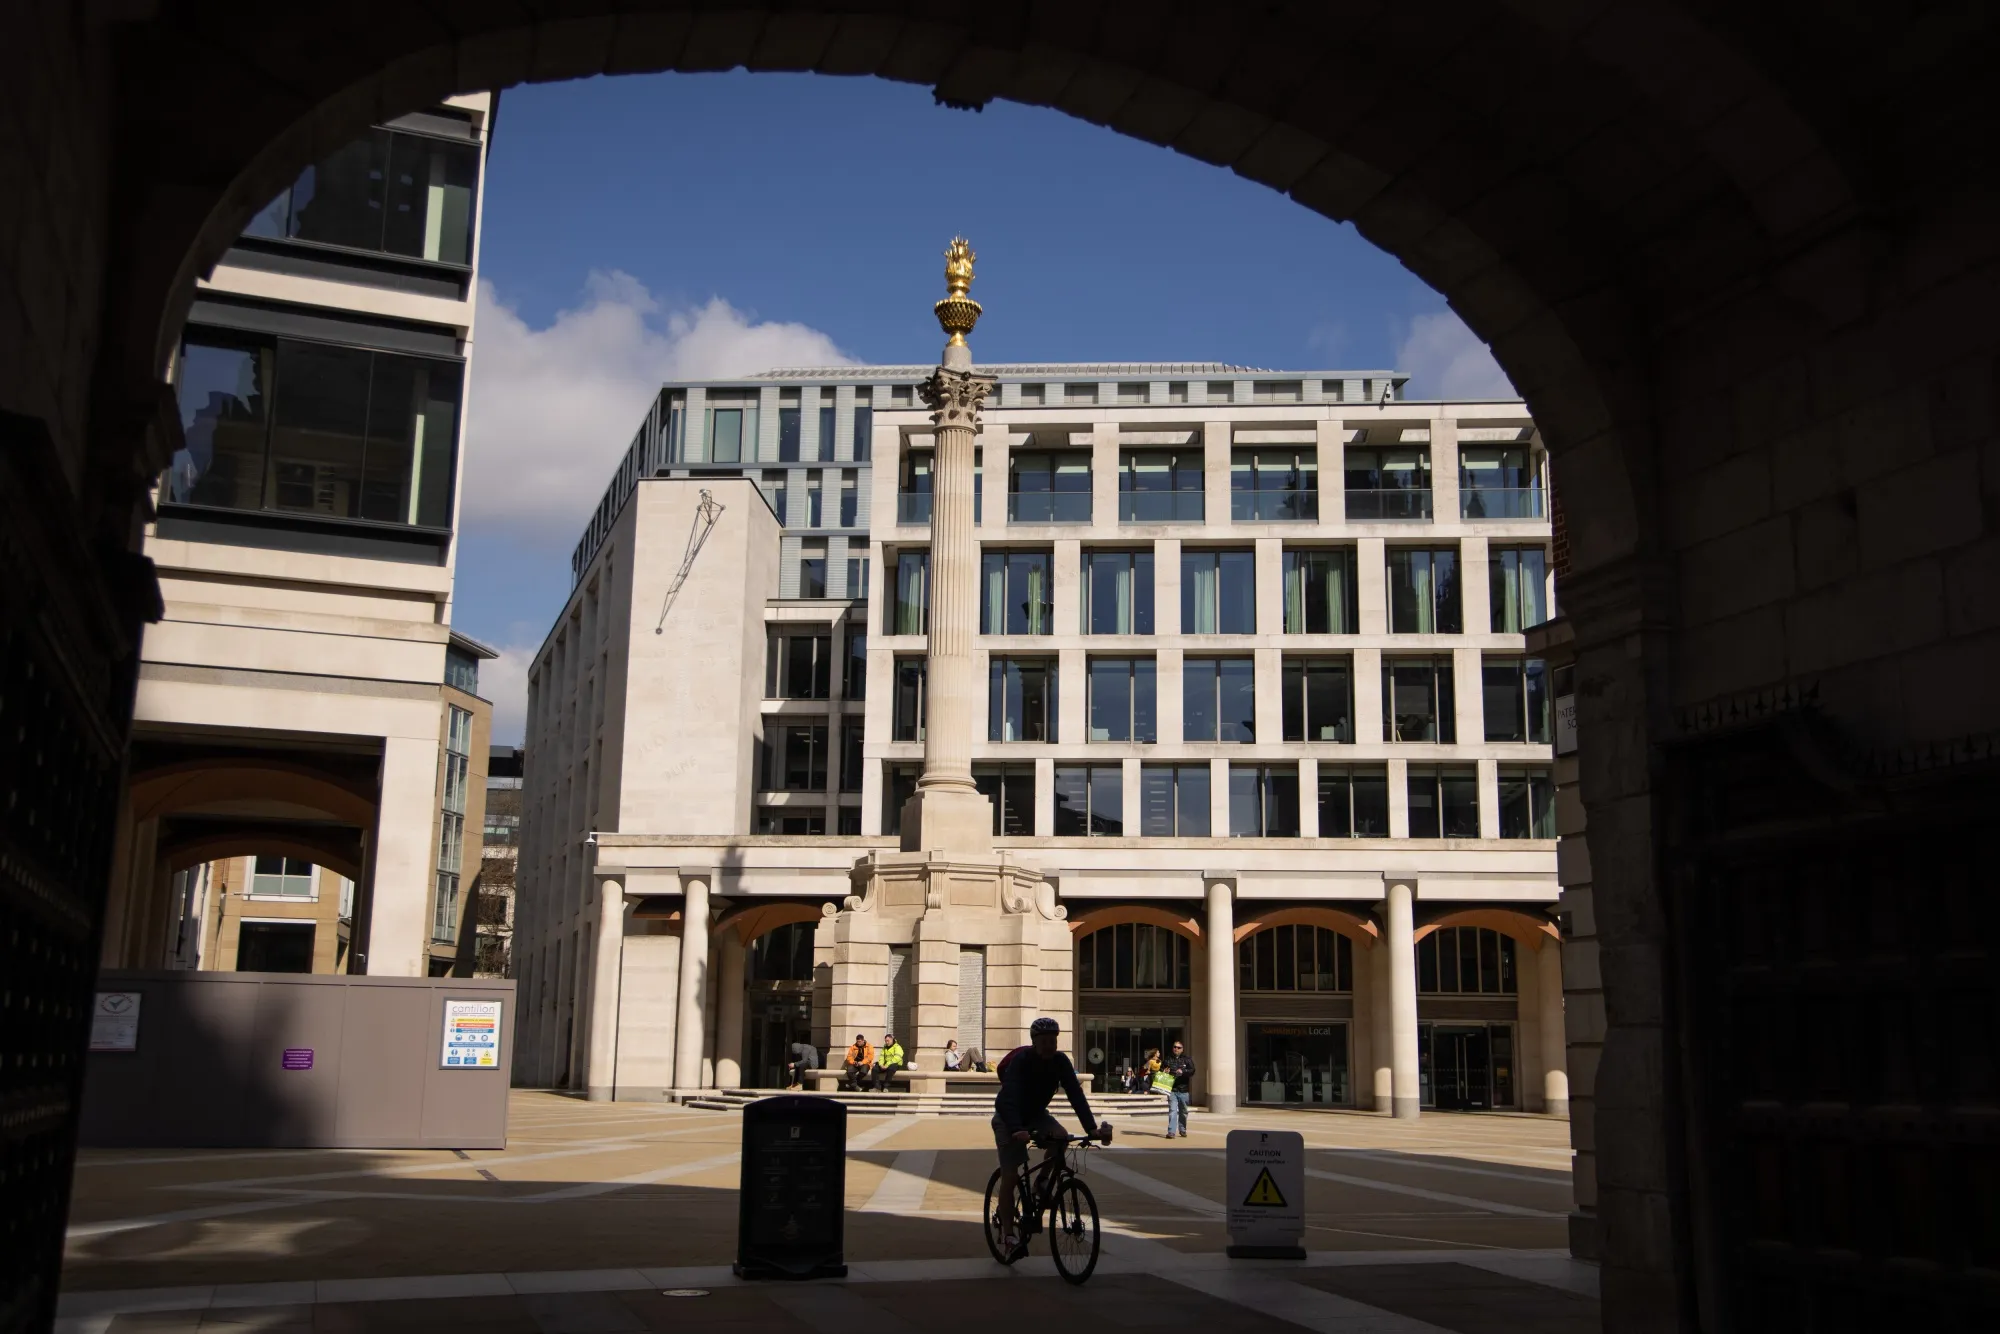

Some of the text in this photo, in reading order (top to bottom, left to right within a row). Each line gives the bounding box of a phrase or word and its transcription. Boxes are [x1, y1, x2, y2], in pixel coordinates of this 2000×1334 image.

[452, 1004, 495, 1013] cantillon
[1308, 1026, 1331, 1035] Local
[1249, 1149, 1281, 1157] CAUTION
